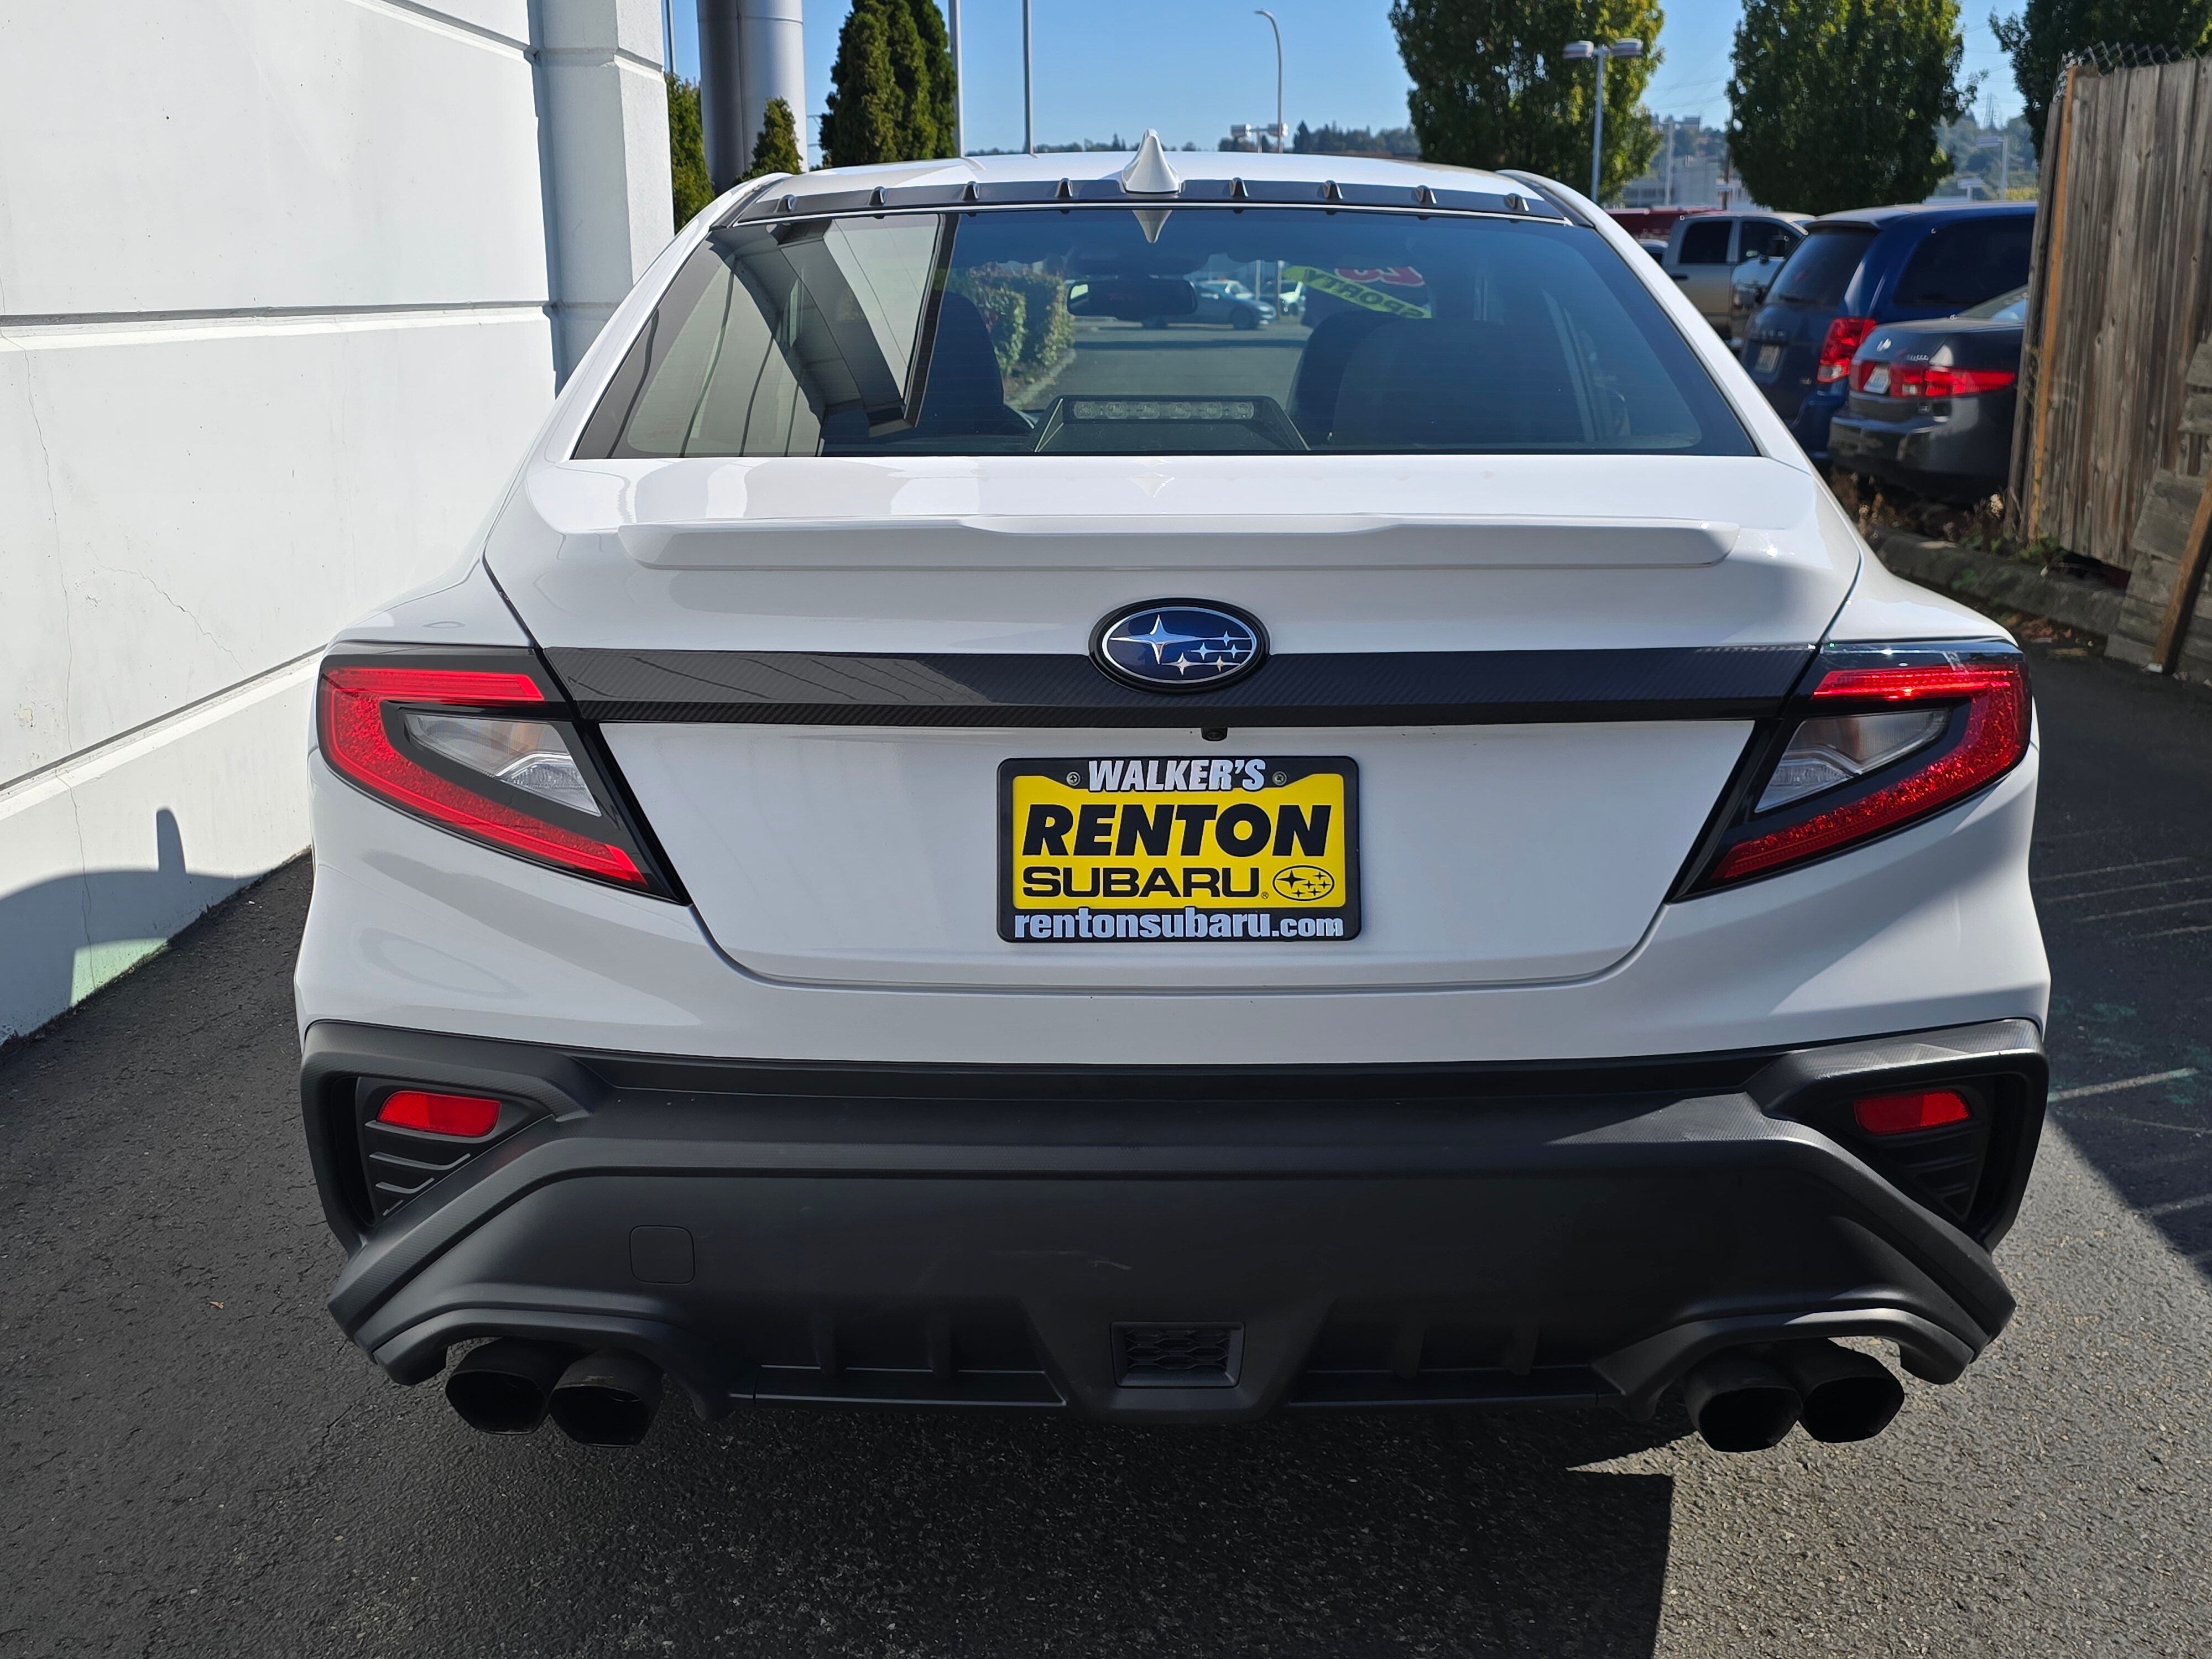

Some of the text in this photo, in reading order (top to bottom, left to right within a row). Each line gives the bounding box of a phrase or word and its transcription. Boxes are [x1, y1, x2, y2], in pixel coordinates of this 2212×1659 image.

[1088, 760, 1266, 791] WALKER'S
[1022, 804, 1332, 857] RENTON
[1022, 867, 1260, 898] SUBARU
[1014, 907, 1344, 938] rentonsubaru.com
